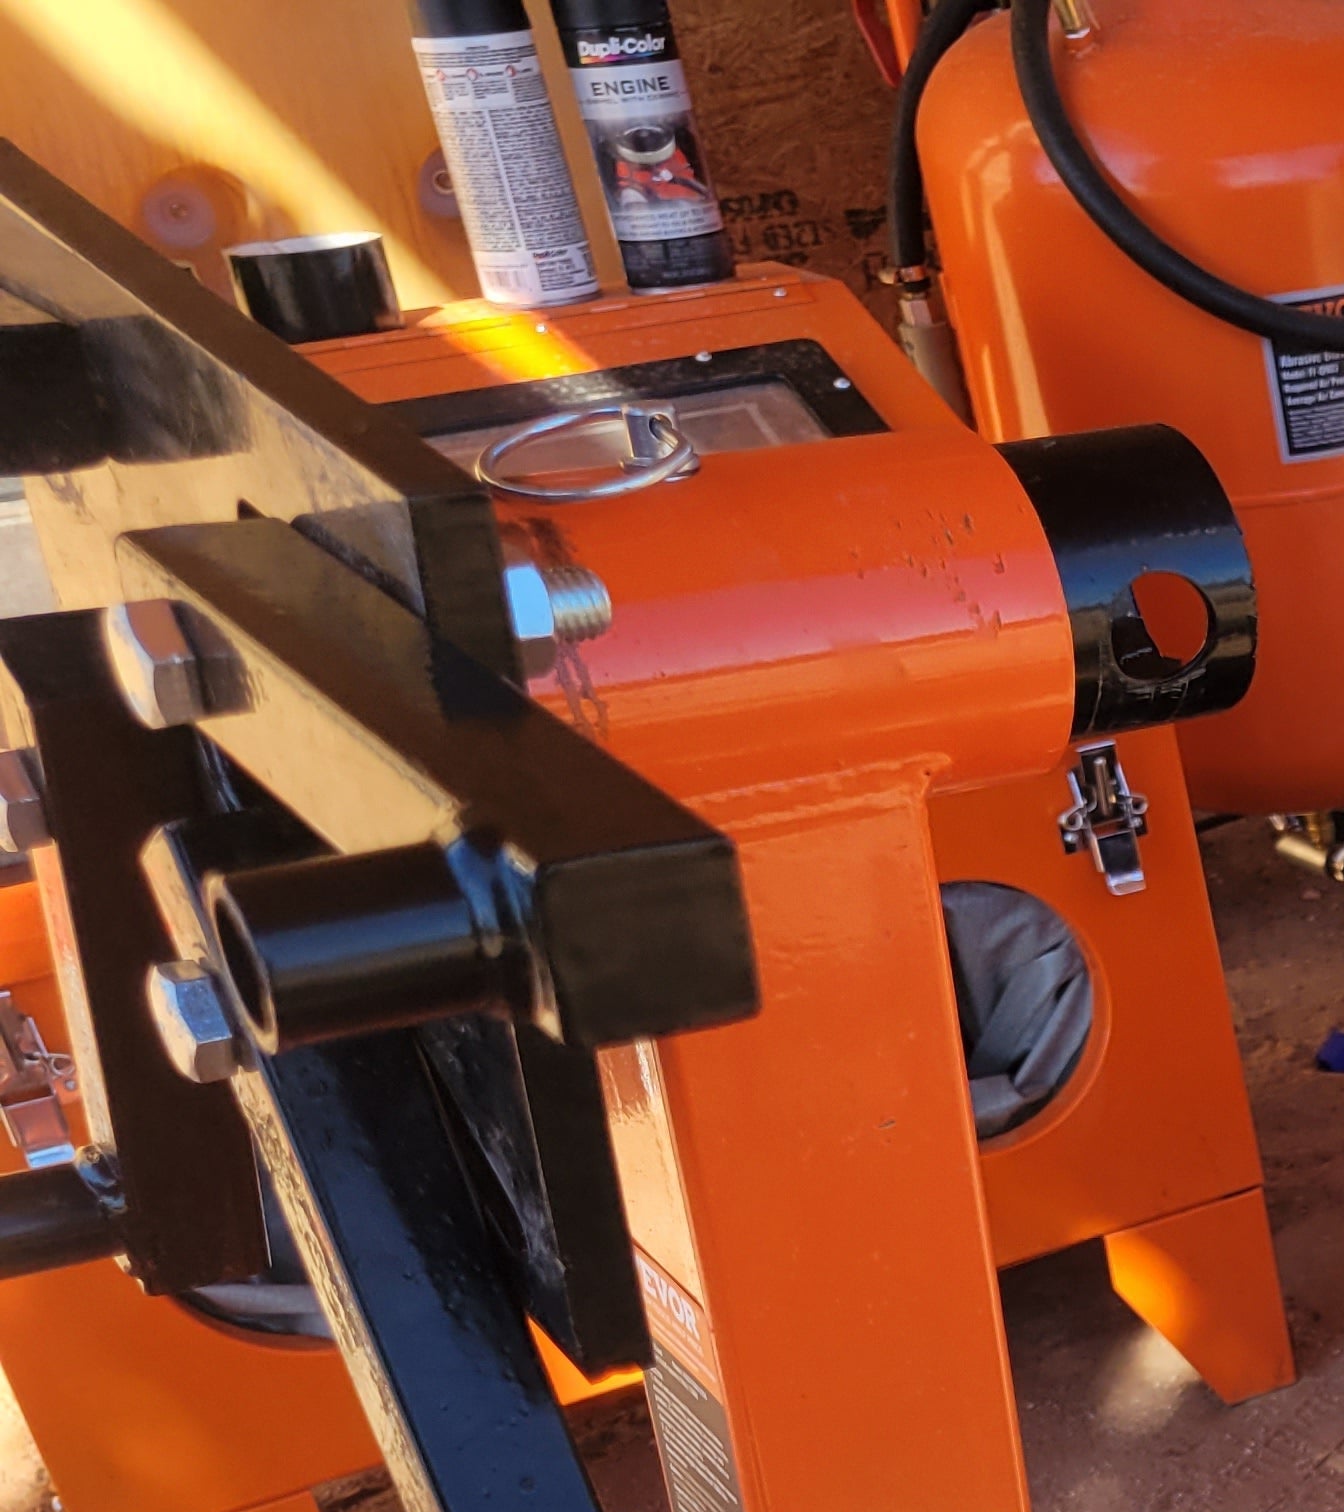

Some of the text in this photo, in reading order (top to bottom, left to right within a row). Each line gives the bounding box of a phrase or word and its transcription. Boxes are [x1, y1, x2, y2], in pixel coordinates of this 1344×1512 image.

[577, 33, 666, 59] Dupli-Color
[590, 76, 671, 97] ENGINE
[635, 1254, 701, 1342] EVOR
